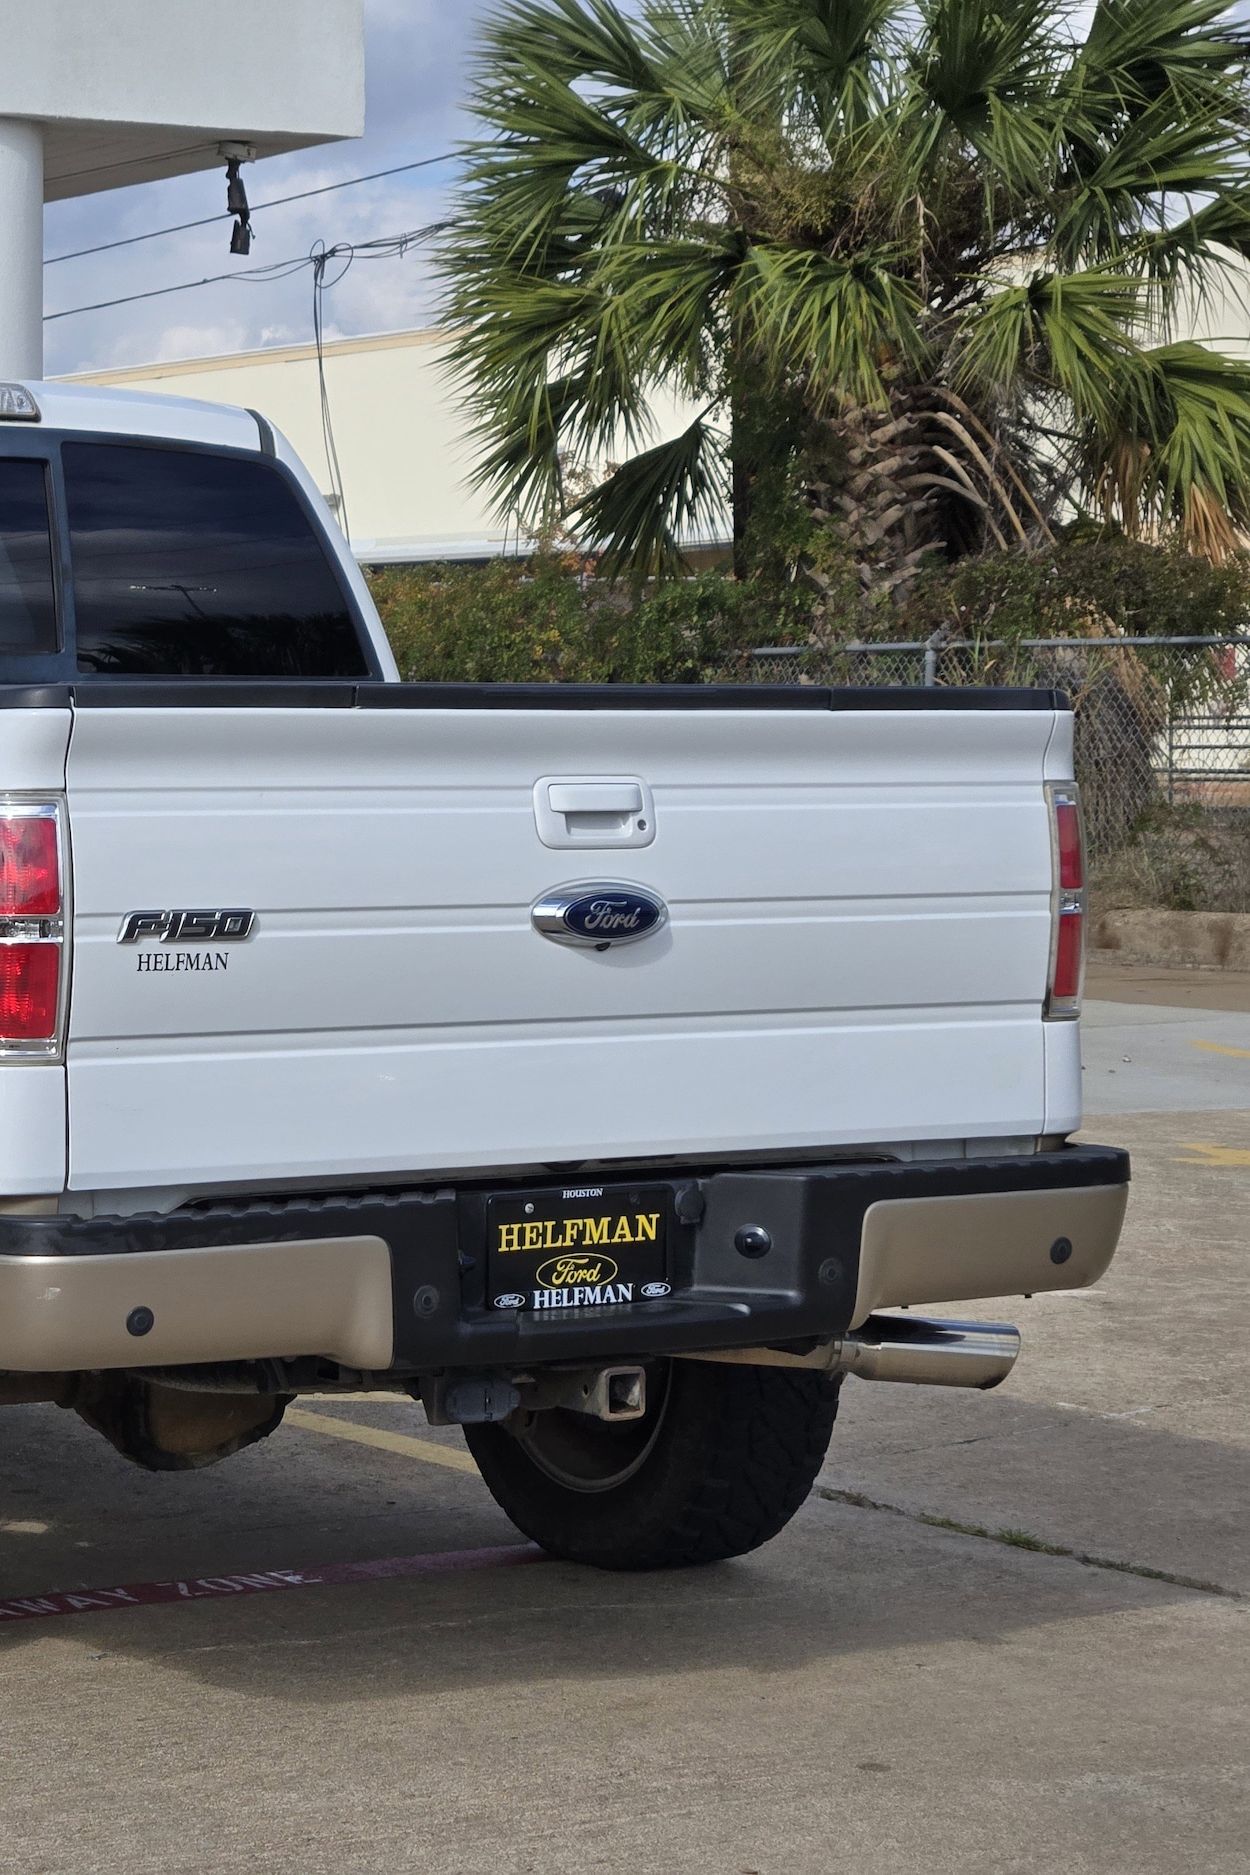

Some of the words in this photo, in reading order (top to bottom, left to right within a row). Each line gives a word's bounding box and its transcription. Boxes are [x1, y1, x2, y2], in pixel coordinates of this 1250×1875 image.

[116, 908, 256, 944] F-150
[584, 900, 641, 929] Ford
[137, 952, 229, 972] HELFMAN
[562, 1188, 603, 1199] HOUSTON
[498, 1213, 660, 1252] HELFMAN
[551, 1257, 602, 1285] Ford
[533, 1283, 633, 1309] HELFMAN
[156, 1569, 323, 1597] ZONE
